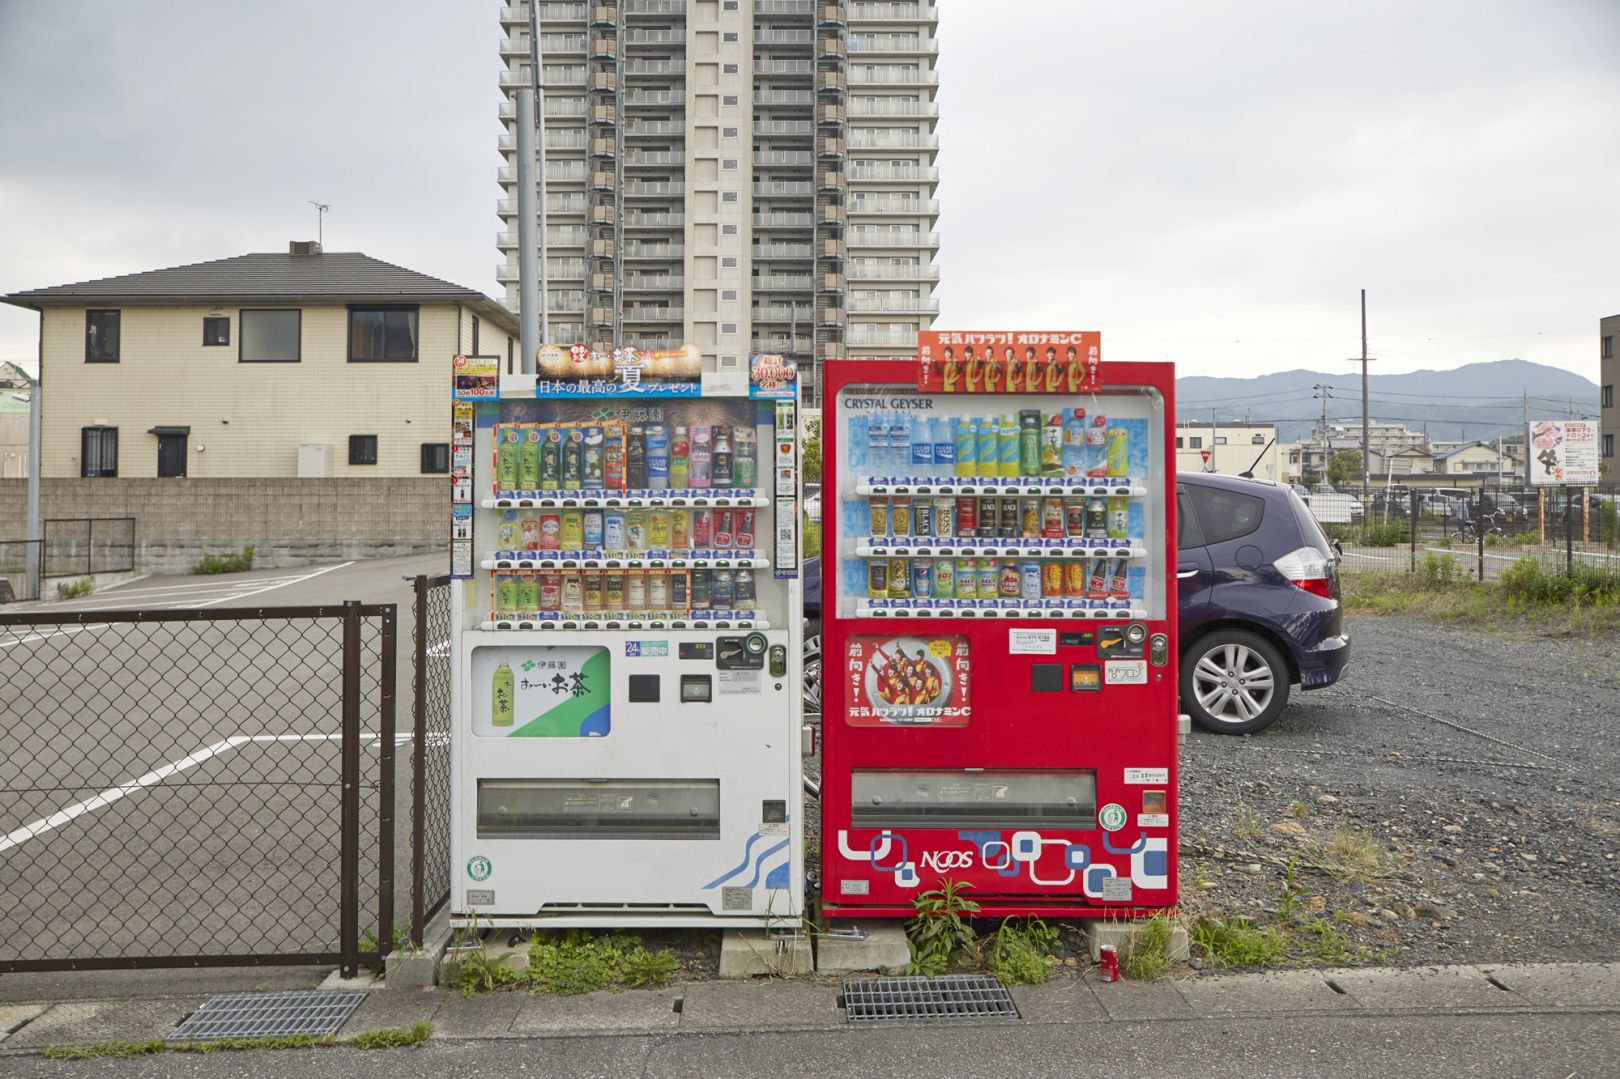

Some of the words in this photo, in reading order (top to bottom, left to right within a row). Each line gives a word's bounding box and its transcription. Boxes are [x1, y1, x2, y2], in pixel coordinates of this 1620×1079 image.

[938, 332, 1014, 345] 元気ハツラツ!
[1017, 332, 1083, 345] オロナミンC
[752, 366, 795, 380] 30,000
[844, 398, 888, 409] CRYSTAL
[890, 398, 933, 409] GEYSER
[921, 509, 930, 534] BLACK
[943, 509, 951, 534] BOSS
[537, 660, 567, 670] 伊藤園
[955, 642, 970, 702] 前向き!
[849, 642, 863, 703] 前向き!
[849, 706, 913, 717] 元気ハツラツ!
[916, 706, 972, 717] オロナミンC
